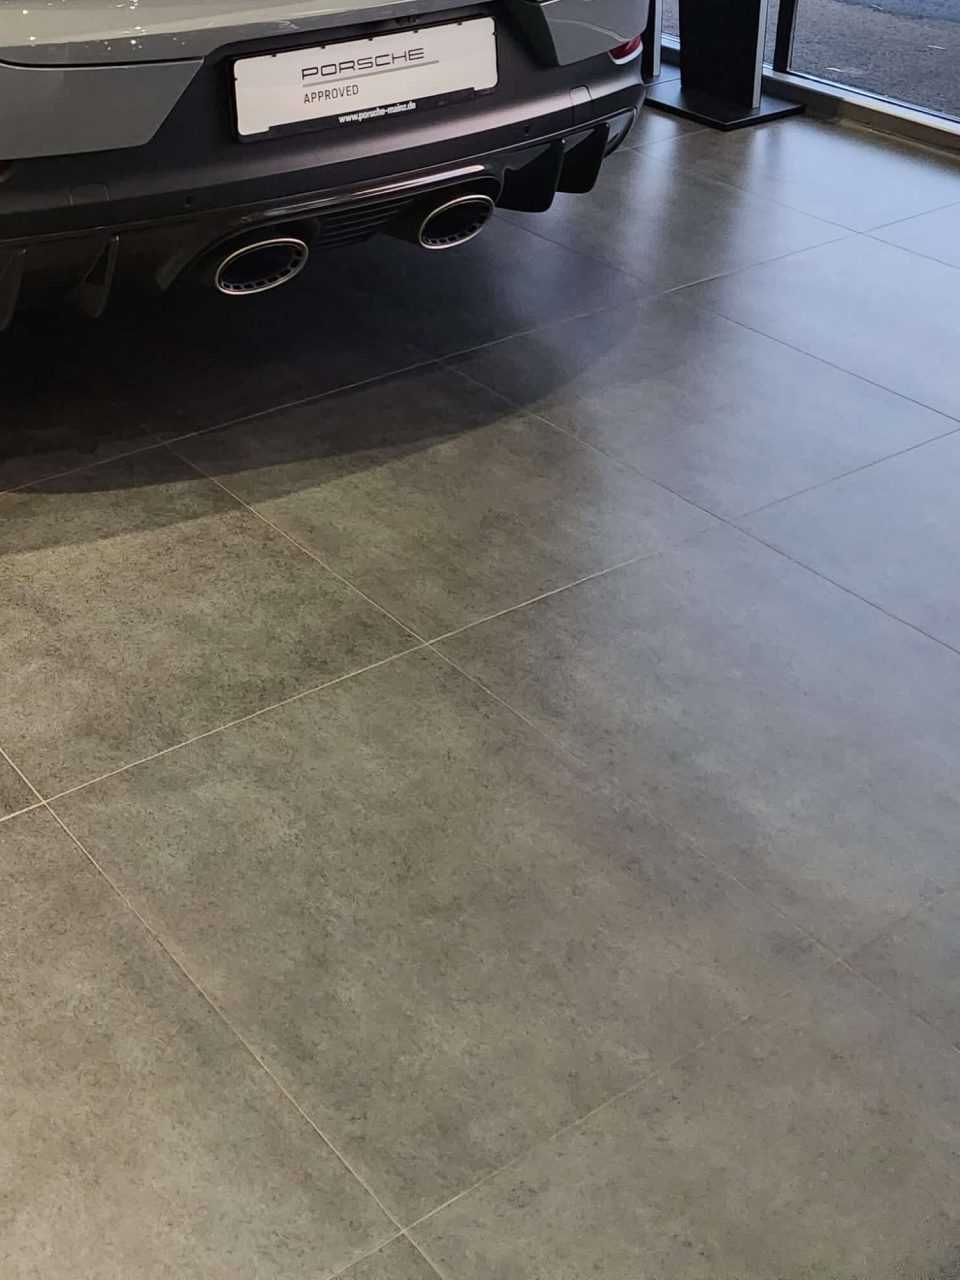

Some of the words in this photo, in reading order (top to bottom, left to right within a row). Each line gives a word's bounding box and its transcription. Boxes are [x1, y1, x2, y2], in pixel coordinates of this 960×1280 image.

[301, 48, 424, 80] PORSCHE
[303, 84, 359, 104] APPROVED
[338, 101, 416, 123] www.porsche-mainz.de
